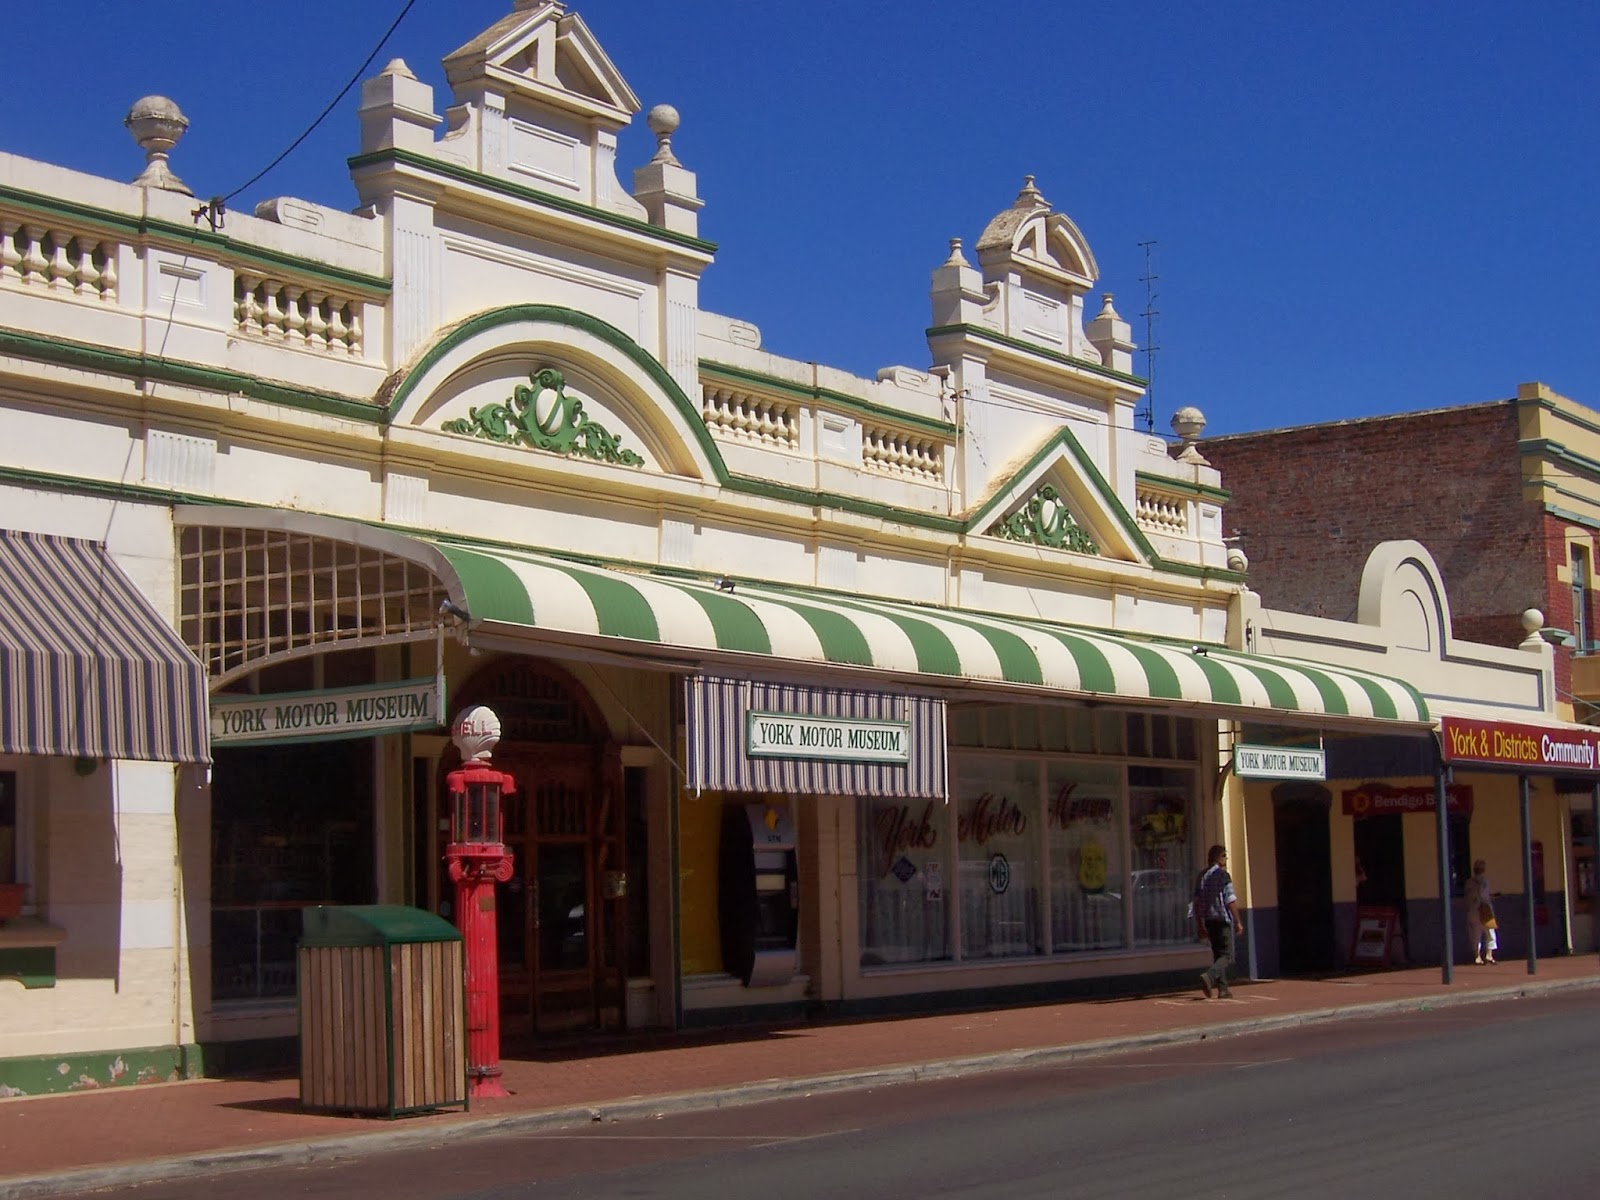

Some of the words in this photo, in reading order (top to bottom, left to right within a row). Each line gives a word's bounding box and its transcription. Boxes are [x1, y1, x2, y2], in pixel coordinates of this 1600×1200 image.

[221, 708, 266, 735] YORK
[275, 701, 338, 729] MOTOR
[346, 692, 429, 723] MUSEUM
[760, 722, 794, 746] YORK
[799, 726, 843, 748] MOTOR
[848, 729, 901, 751] MUSEUM
[1450, 727, 1477, 756] York
[1480, 729, 1489, 757] &
[1494, 731, 1538, 760] Districts
[1542, 734, 1594, 769] Community
[1240, 752, 1260, 769] YORK
[1262, 754, 1287, 771] MOTOR
[1289, 756, 1320, 773] MUSEUM
[1374, 794, 1424, 809] Bendigo
[1425, 791, 1459, 806] Bk
[874, 801, 937, 879] York
